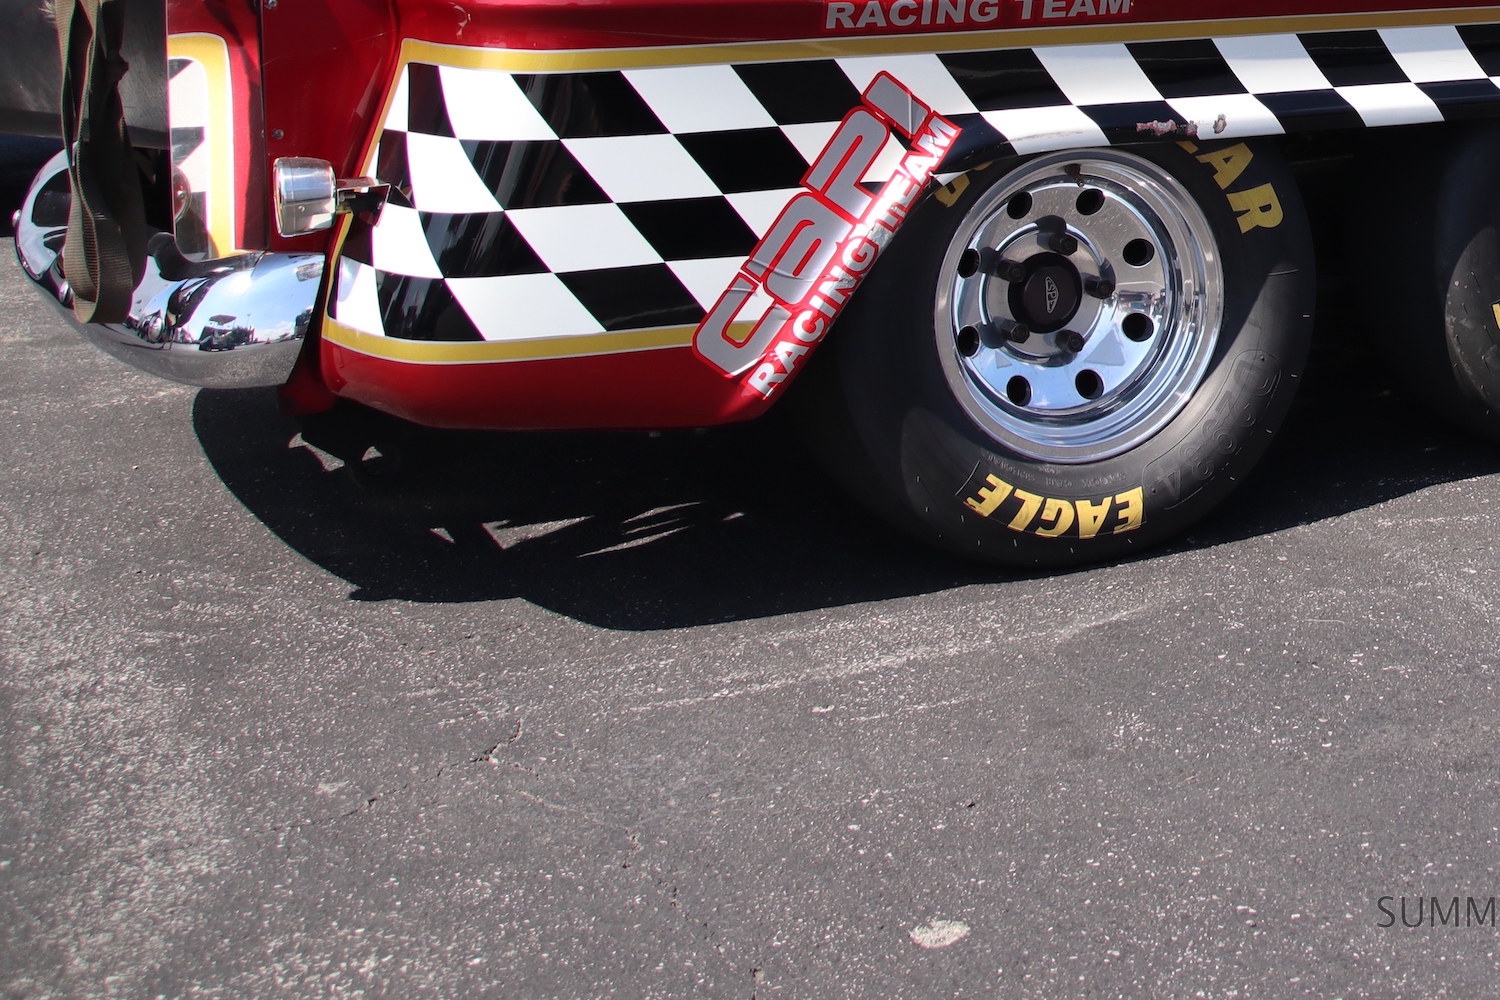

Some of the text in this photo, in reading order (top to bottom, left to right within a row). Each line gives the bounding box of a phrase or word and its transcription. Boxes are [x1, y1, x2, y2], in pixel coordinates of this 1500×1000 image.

[747, 113, 957, 399] RACING TEAM
[963, 473, 1144, 539] EAGLE
